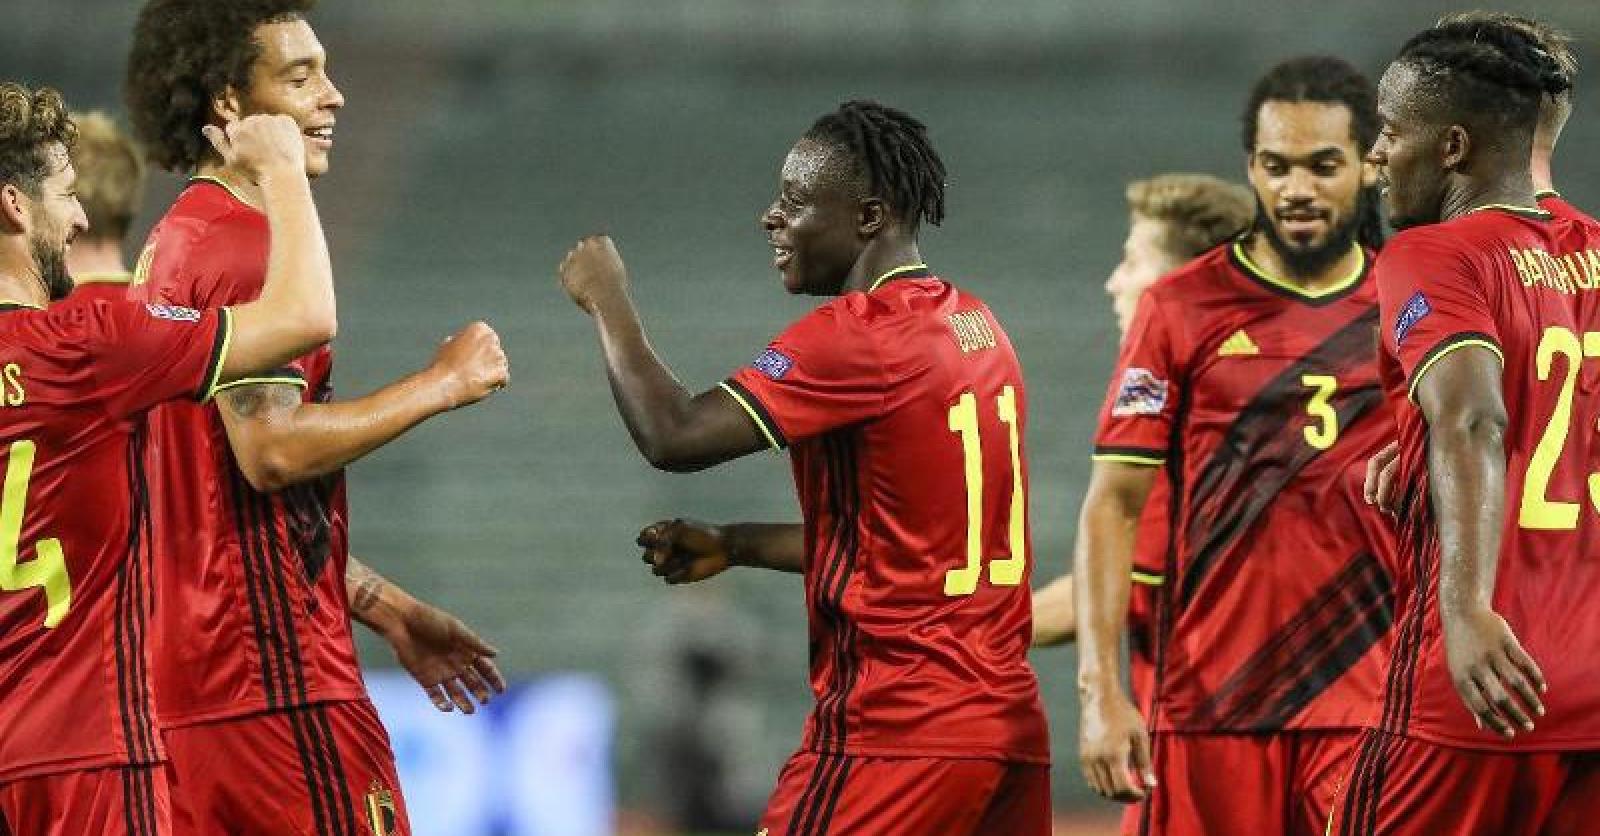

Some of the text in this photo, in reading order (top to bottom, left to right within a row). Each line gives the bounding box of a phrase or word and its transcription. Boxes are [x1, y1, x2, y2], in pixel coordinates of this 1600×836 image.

[1508, 248, 1600, 295] BATSHUA
[0, 363, 25, 406] S
[1302, 375, 1338, 449] 3
[944, 385, 1026, 596] 11
